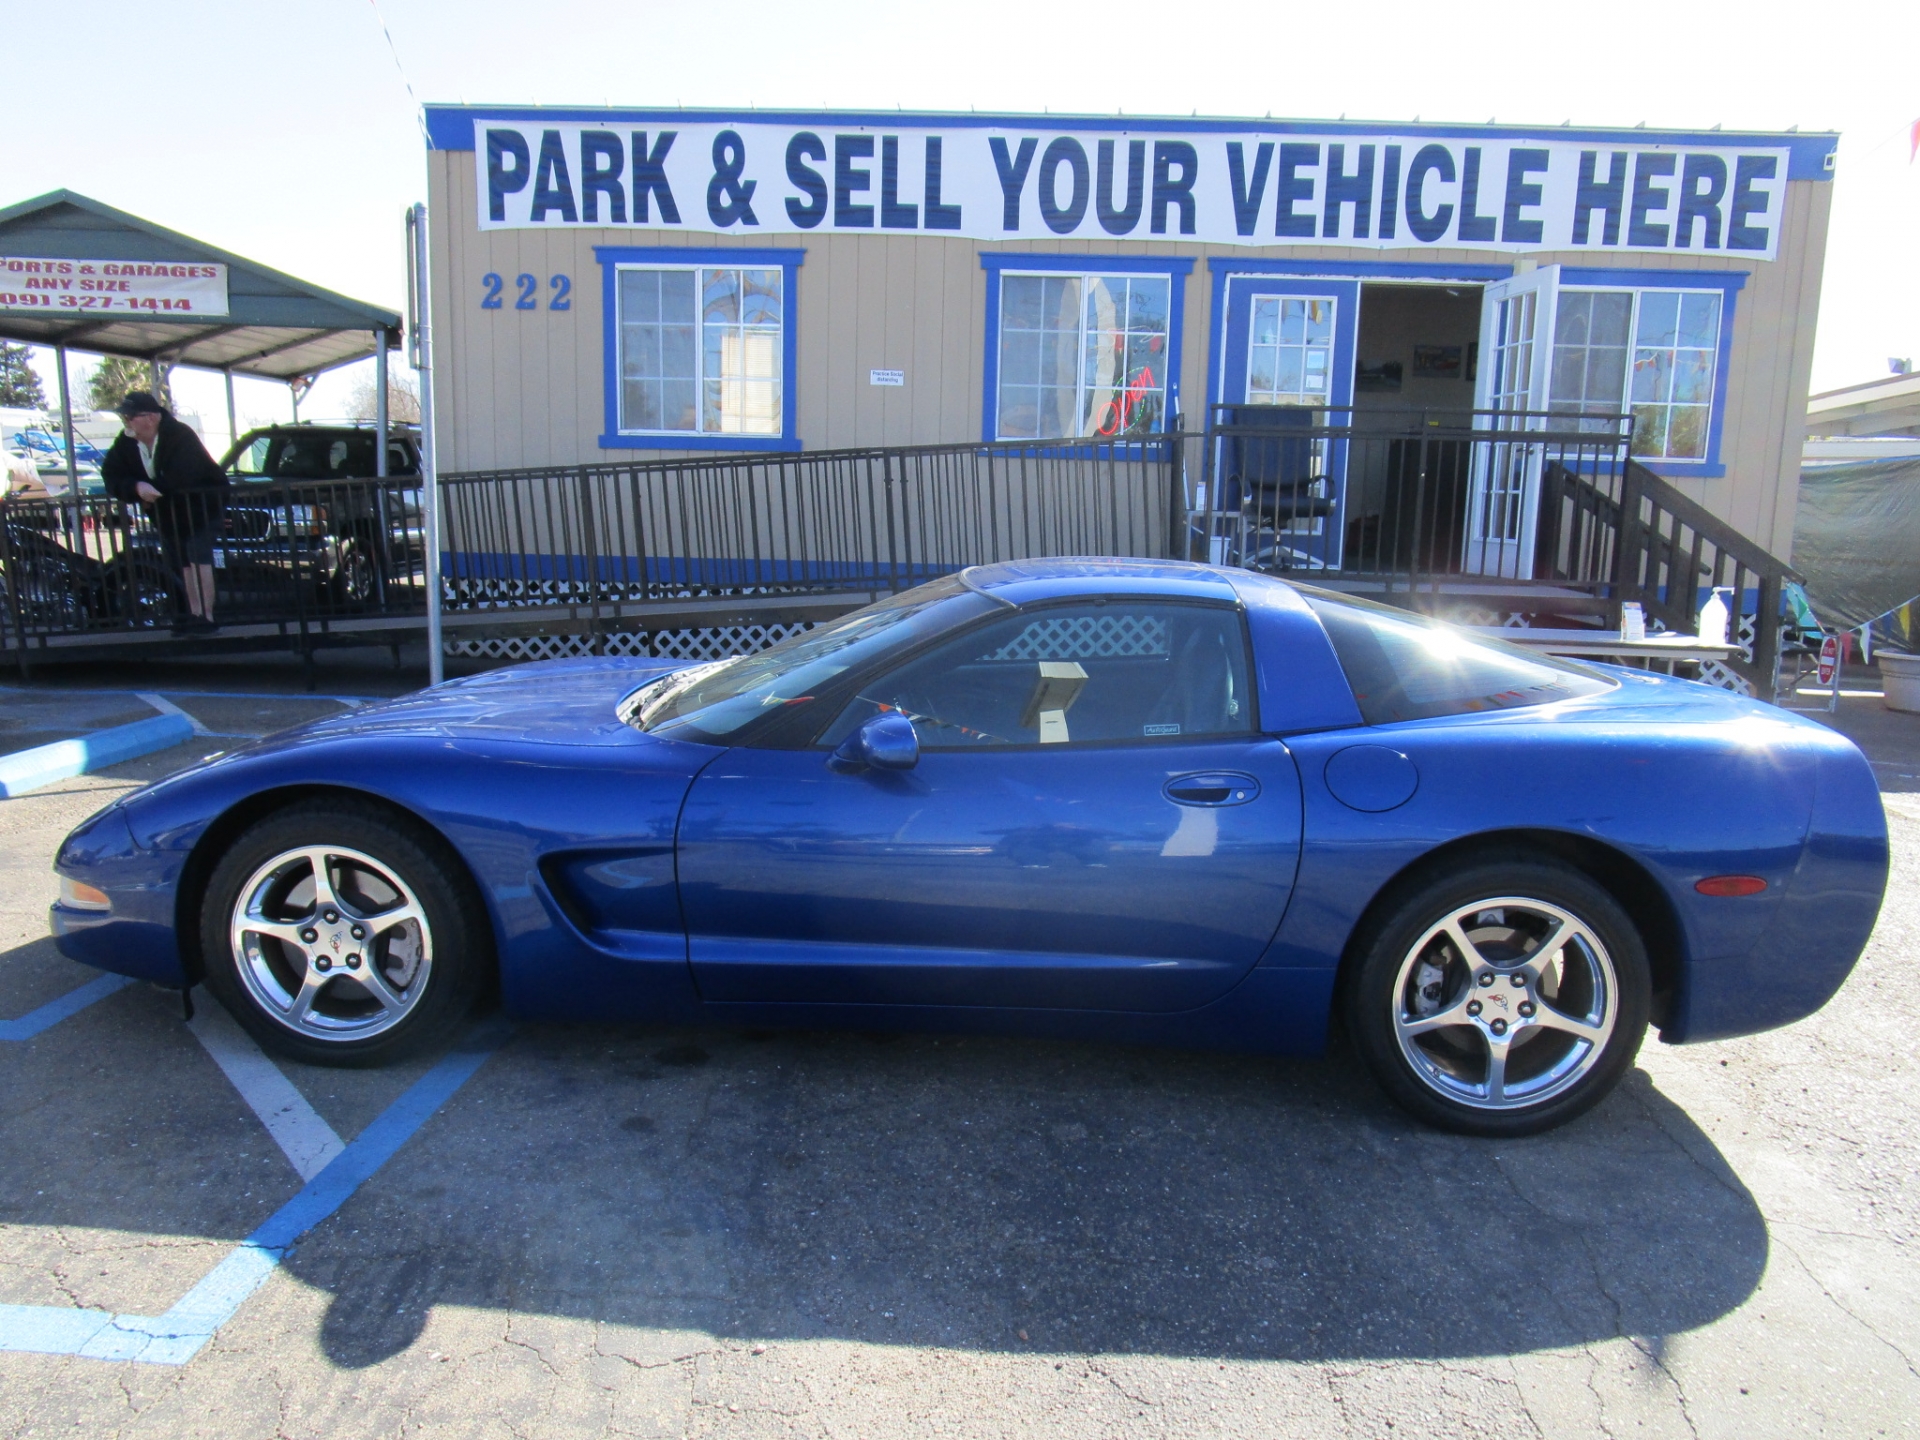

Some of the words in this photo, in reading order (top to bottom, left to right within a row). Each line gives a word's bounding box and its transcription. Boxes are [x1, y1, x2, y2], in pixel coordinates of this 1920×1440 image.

[485, 128, 681, 224] PARK
[706, 129, 760, 228] &
[784, 130, 962, 231] SELL
[988, 136, 1198, 236] YOUR
[1225, 140, 1550, 243] VEHICLE
[1571, 149, 1778, 250] HERE
[78, 263, 97, 275] &
[102, 263, 217, 278] GARAGES
[25, 277, 73, 291] ANY
[79, 279, 131, 293] SIZE
[481, 272, 571, 311] 222
[58, 294, 192, 311] 327-1414
